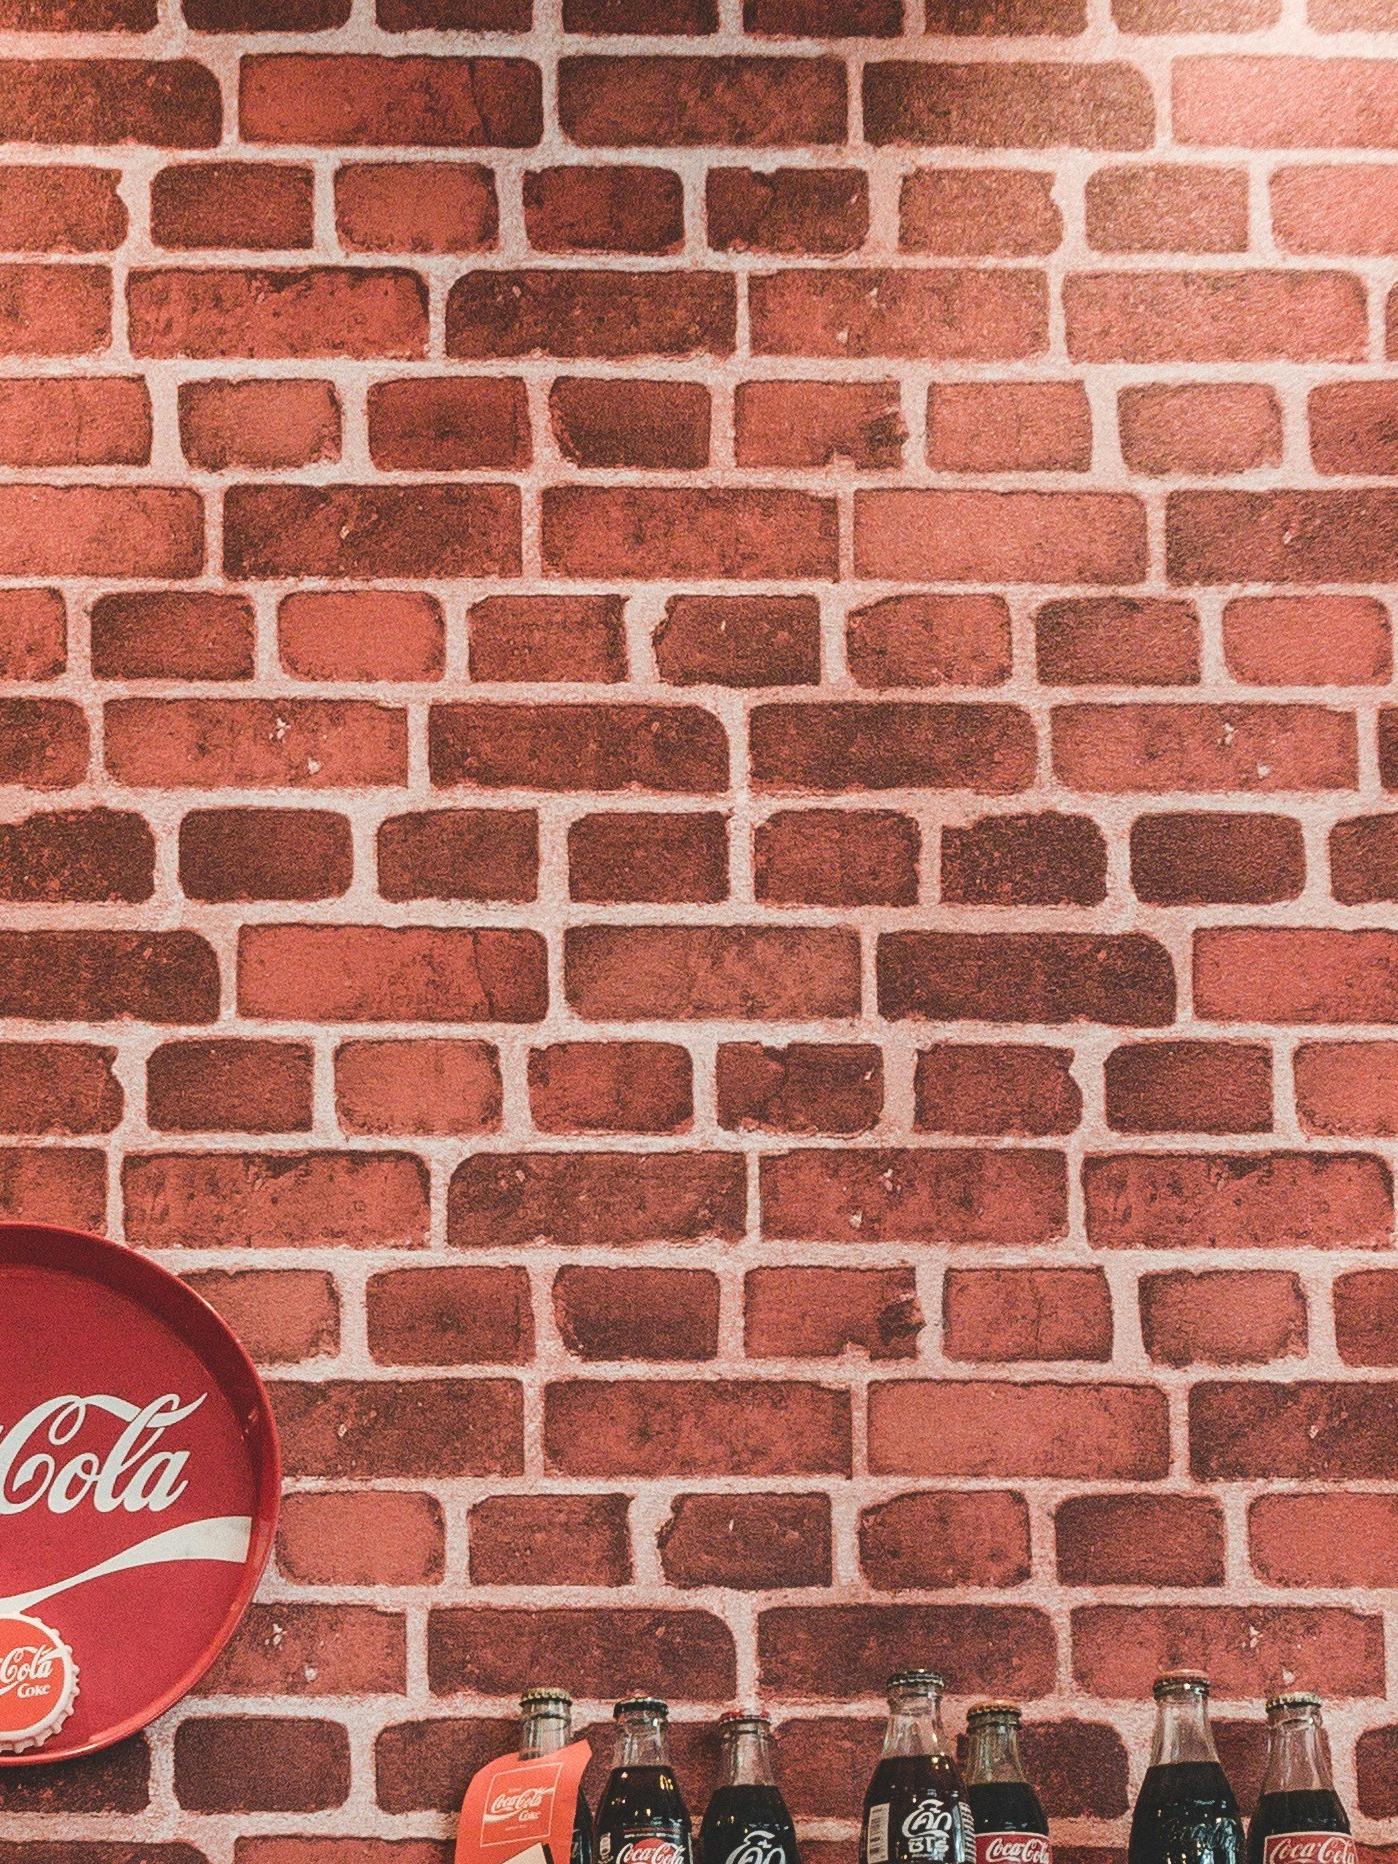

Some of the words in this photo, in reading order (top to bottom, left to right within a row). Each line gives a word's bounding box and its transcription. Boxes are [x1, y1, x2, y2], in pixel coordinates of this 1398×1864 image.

[17, 1683, 51, 1699] Coke
[491, 1787, 543, 1814] Coca-Cola
[518, 1810, 541, 1822] Coke
[986, 1837, 1049, 1864] Coca-Cola
